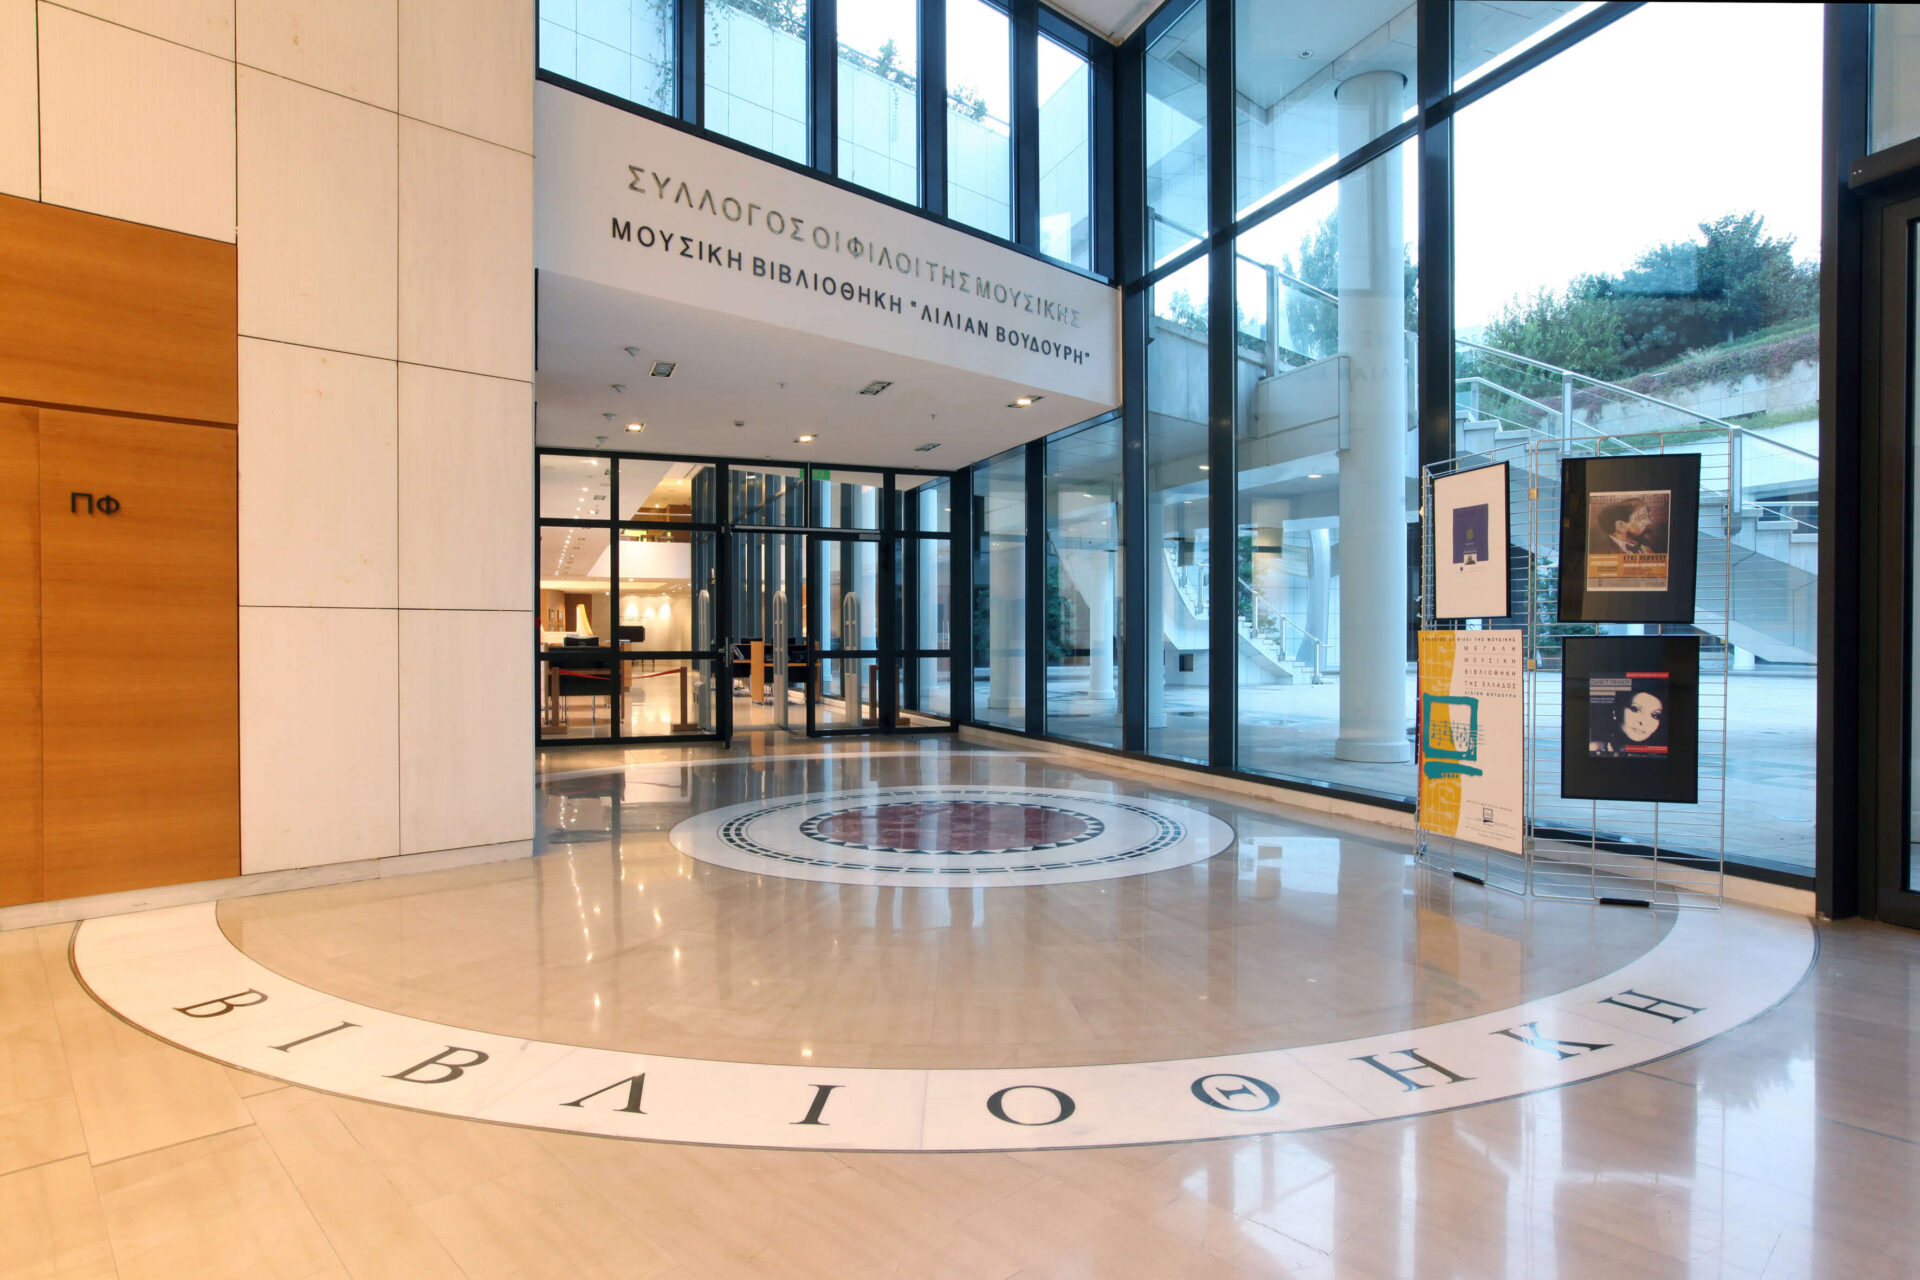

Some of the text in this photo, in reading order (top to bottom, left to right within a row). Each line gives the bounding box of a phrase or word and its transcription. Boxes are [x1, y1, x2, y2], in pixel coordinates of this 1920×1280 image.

[612, 217, 1090, 365] ΜΟΥΣΙΚΗ ΒΙΒΛΙΟΘΗΚΗ "ΛΙΛΙΑΝ ΒΟΥΔΟΥΡΗ"
[628, 165, 1082, 328] ΣΥΛΛΟΓΟΣ ΟΙ ΦΙΛΟΙ ΤΗΣ ΜΟΥΣΙΚΗΣ
[71, 492, 121, 515] ΠΦ
[172, 988, 1707, 1126] ΒΙΒΛΙΟΘΗΚΗ
